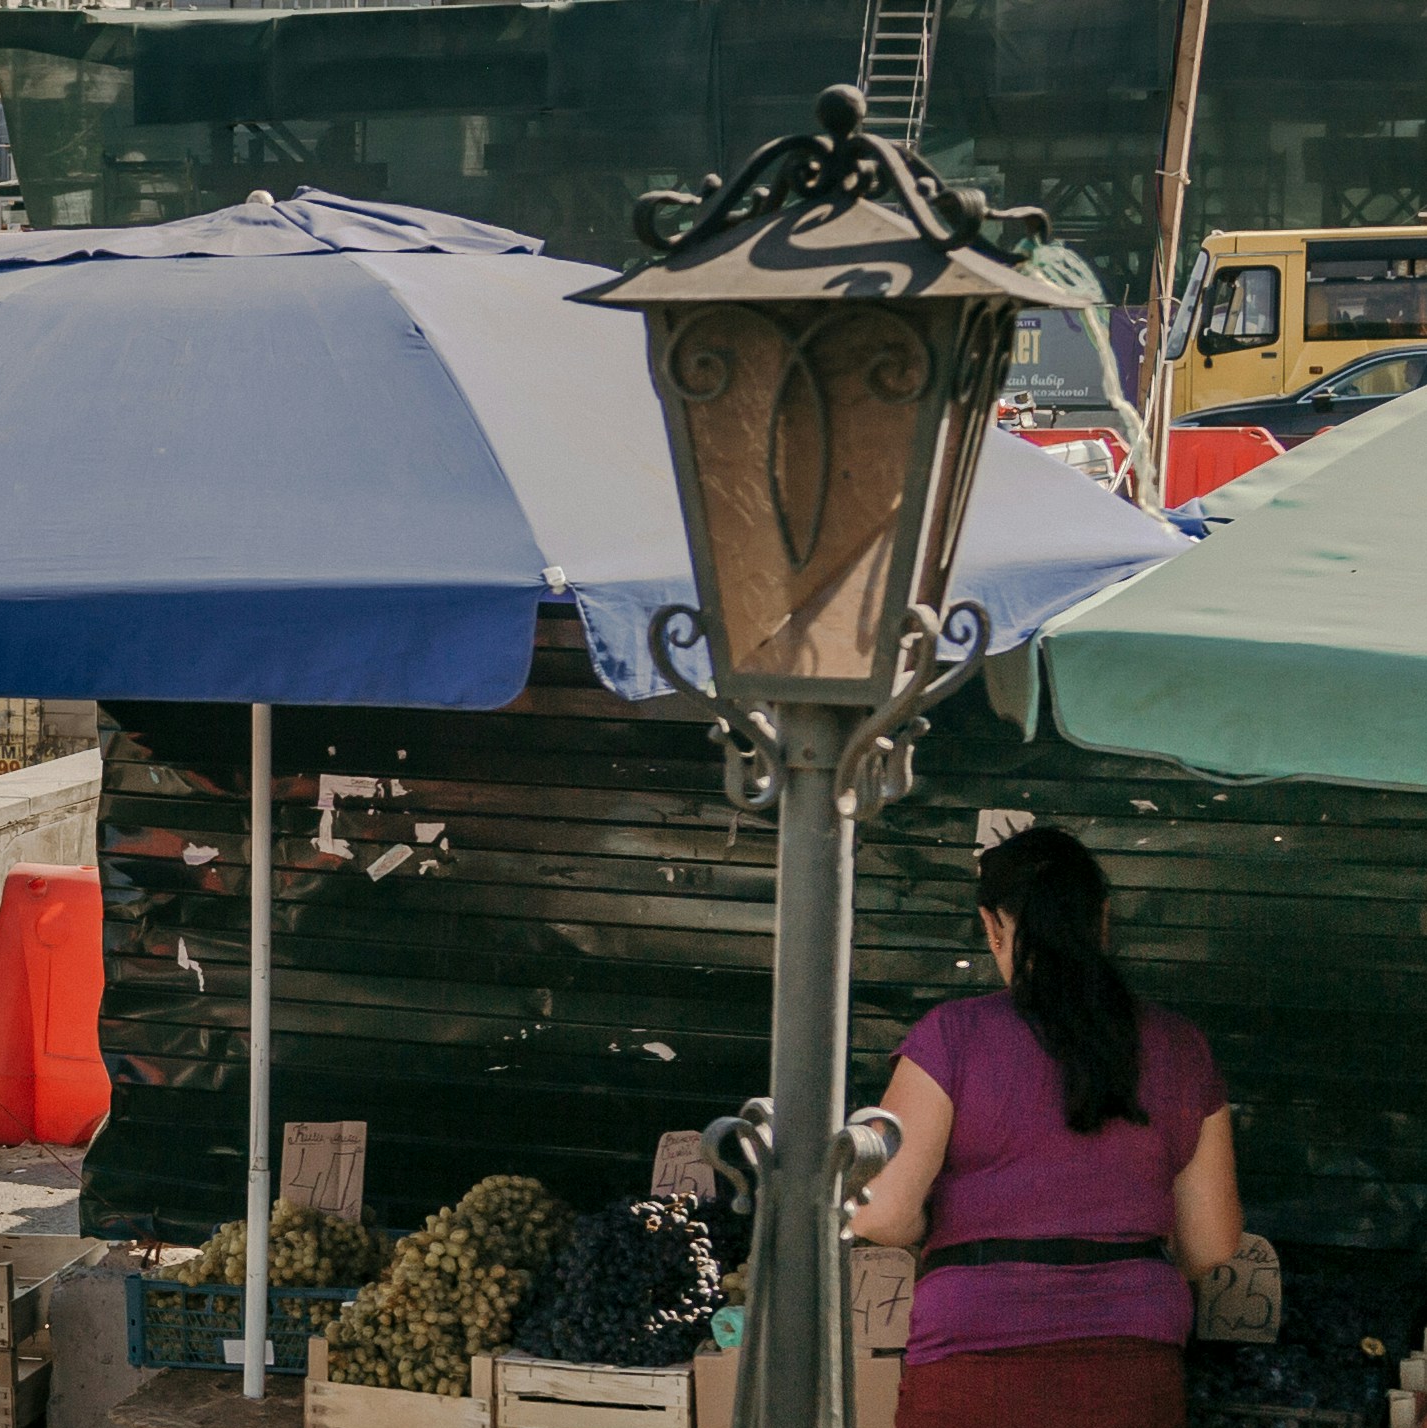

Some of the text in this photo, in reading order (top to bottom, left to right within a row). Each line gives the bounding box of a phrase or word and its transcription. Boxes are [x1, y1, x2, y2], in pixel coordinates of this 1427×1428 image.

[1030, 374, 1065, 388] вибір
[656, 1159, 707, 1196] 45
[851, 1270, 910, 1334] 47
[1208, 1264, 1279, 1332] 25
